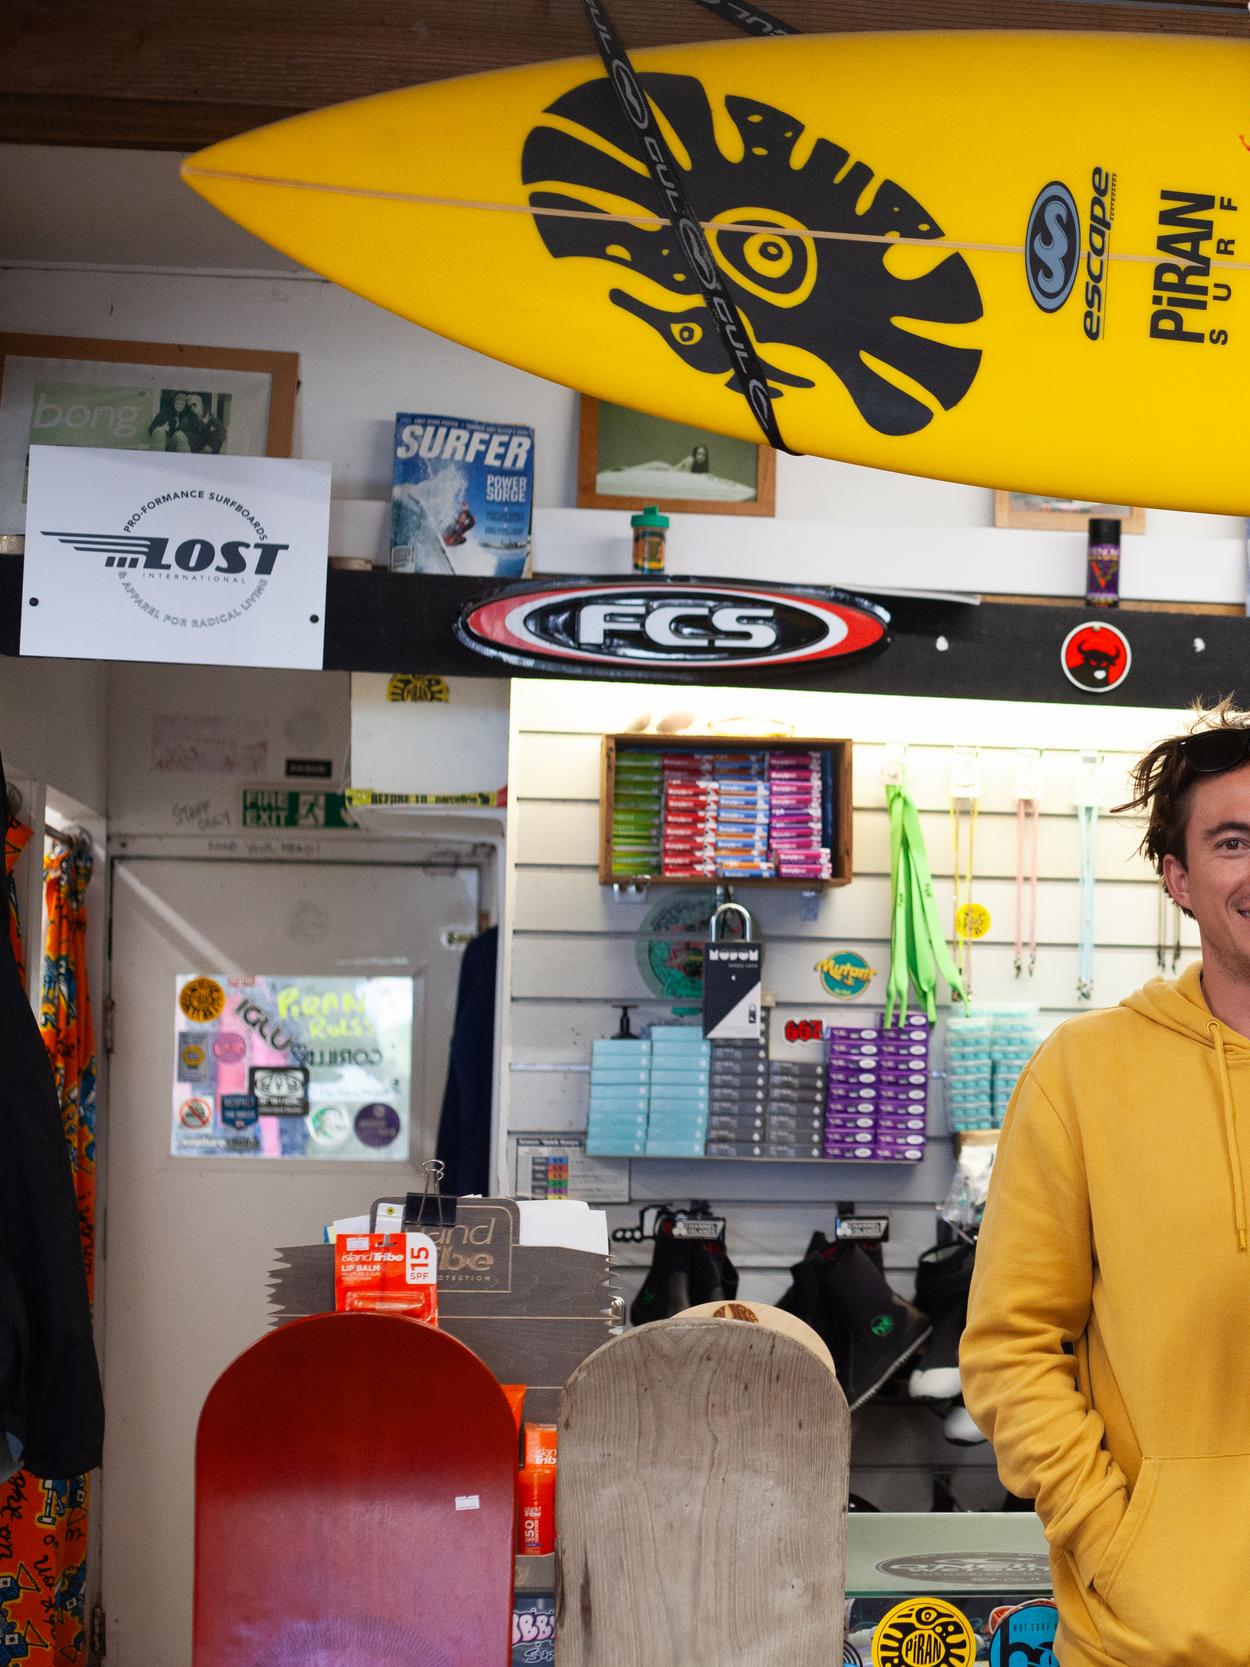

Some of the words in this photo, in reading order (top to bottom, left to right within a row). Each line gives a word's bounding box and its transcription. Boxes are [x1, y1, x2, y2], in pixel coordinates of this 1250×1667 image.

[1083, 166, 1111, 341] escape
[1209, 196, 1238, 346] SURF
[396, 424, 532, 470] SURFER
[486, 475, 527, 489] POWER
[486, 488, 526, 502] SURGE
[123, 490, 205, 533] PRO-FORMANCE
[208, 492, 268, 541] SURFBOARDS
[143, 537, 290, 576] LOST
[142, 572, 246, 584] INTERNATIONAL
[121, 580, 160, 620] APPAREL
[163, 613, 187, 628] FOR
[191, 608, 242, 628] RADICAL
[578, 604, 778, 650] FCS
[410, 1272, 429, 1280] SPF
[535, 1447, 556, 1457] islan
[535, 1456, 556, 1465] Trib
